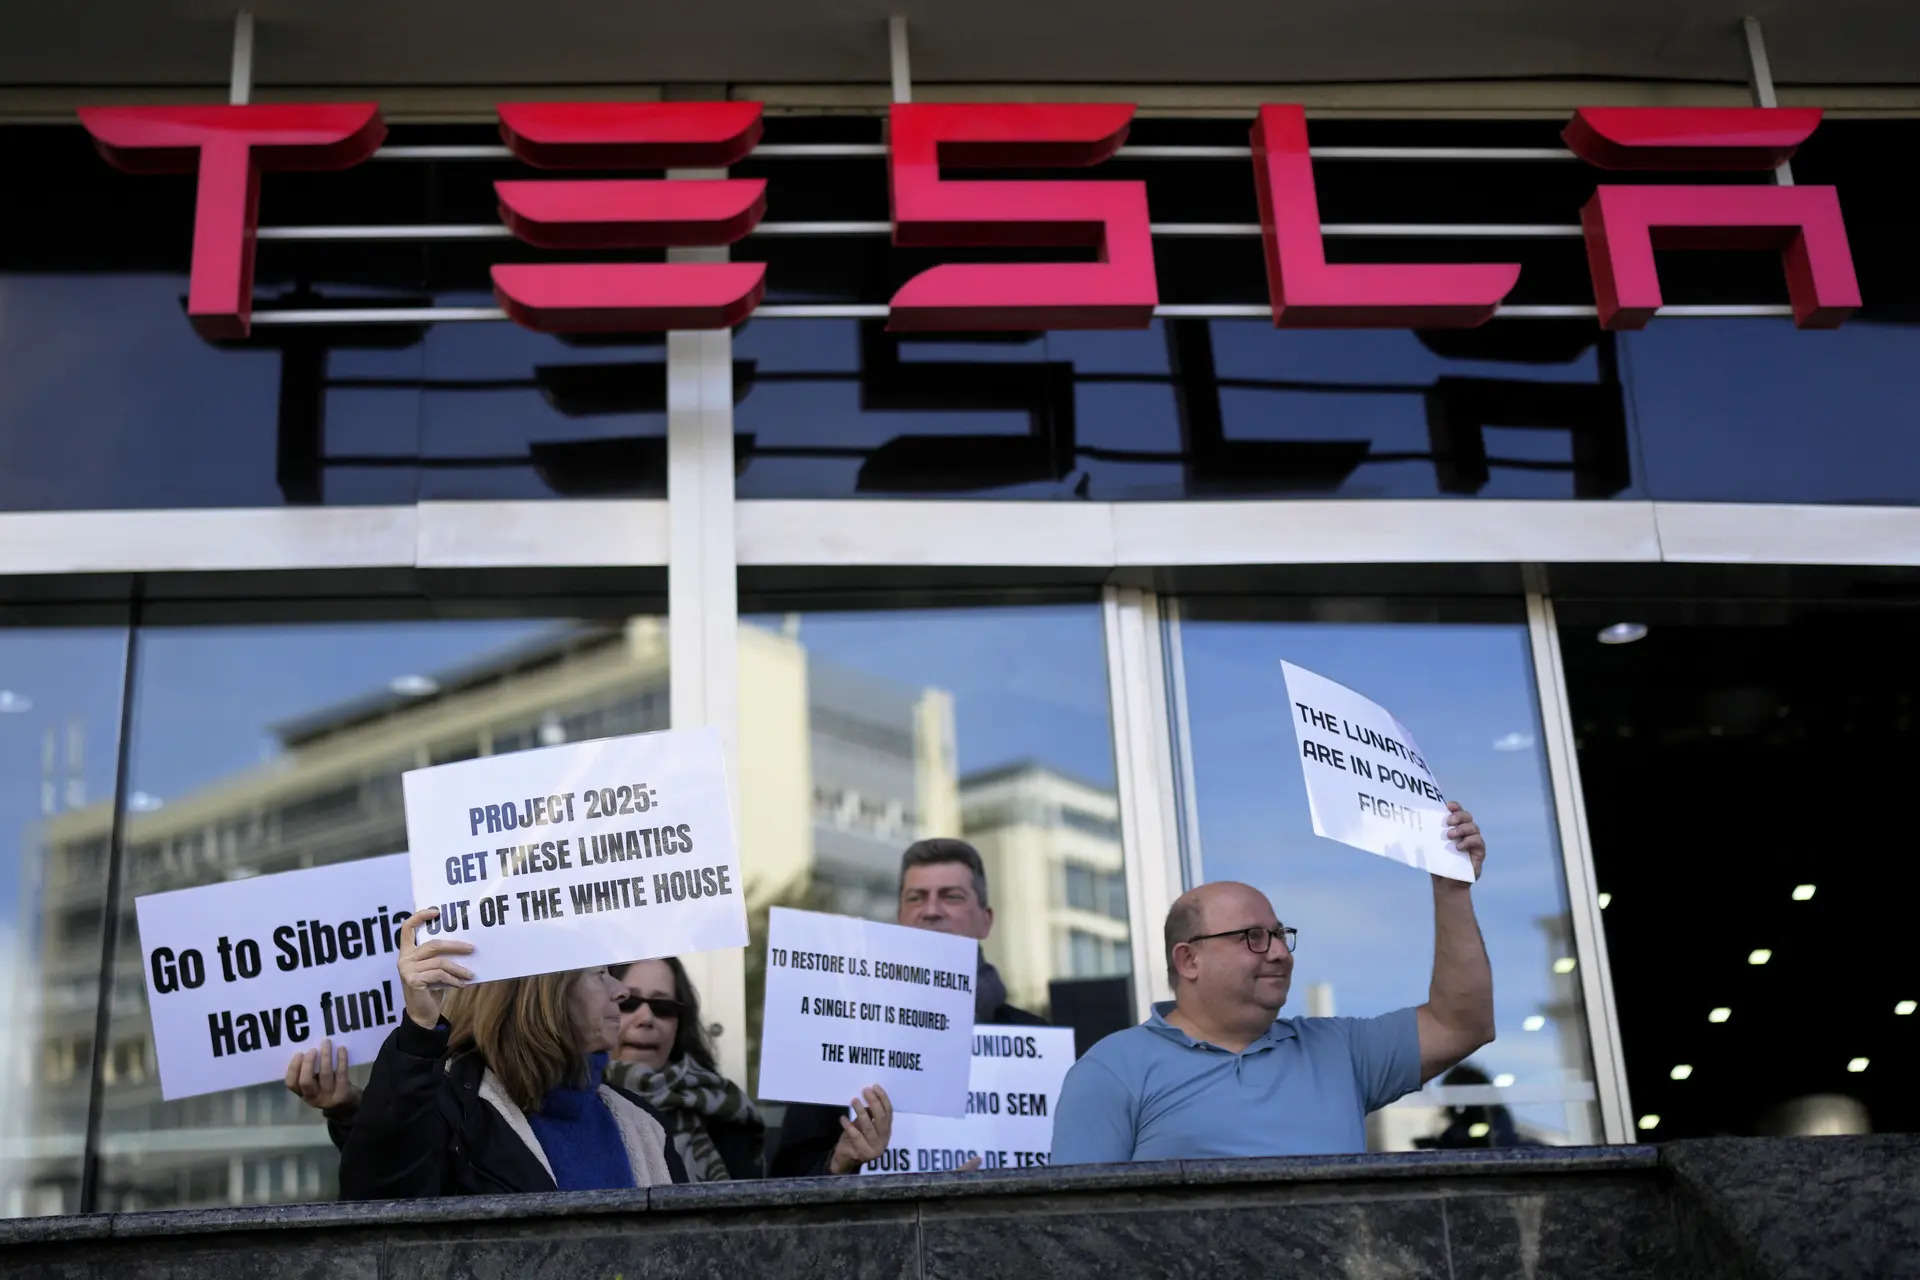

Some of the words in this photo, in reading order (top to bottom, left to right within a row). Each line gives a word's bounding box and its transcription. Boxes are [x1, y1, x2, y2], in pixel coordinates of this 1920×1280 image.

[76, 101, 1862, 338] TESLA
[1296, 702, 1340, 735] THE
[1344, 720, 1431, 775] LUNATIC
[1303, 739, 1346, 770] ARE
[1351, 755, 1372, 779] IN
[469, 793, 575, 836] PROJECT
[584, 783, 658, 819] 2025:
[1358, 792, 1422, 831] FIGHT!
[446, 851, 488, 885] GET
[496, 839, 572, 877] THESE
[579, 824, 693, 866] LUNATICS
[425, 900, 470, 935] OUT
[480, 895, 510, 927] OF
[517, 888, 563, 921] THE
[569, 876, 647, 915] WHITE
[653, 865, 732, 903] HOUSE
[151, 947, 205, 993] Go
[217, 936, 262, 982] to
[772, 949, 787, 967] TO
[791, 950, 845, 974] RESTORE
[848, 957, 870, 977] U.S.
[875, 961, 930, 986] ECONOMIC
[933, 970, 972, 994] HEALTH,
[208, 1004, 310, 1058] Have
[320, 980, 397, 1036] fun!
[801, 996, 809, 1015] A
[814, 998, 856, 1019] SINGLE
[860, 1003, 881, 1022] CUT
[885, 1006, 895, 1023] IS
[899, 1008, 950, 1031] REQUIRED:
[822, 1043, 844, 1063] THE
[848, 1046, 885, 1067] WHITE
[888, 1050, 923, 1072] HOUSE.
[972, 1035, 1042, 1059] UNIDOS.
[1007, 1093, 1047, 1116] SEM
[985, 1150, 1007, 1168] DE
